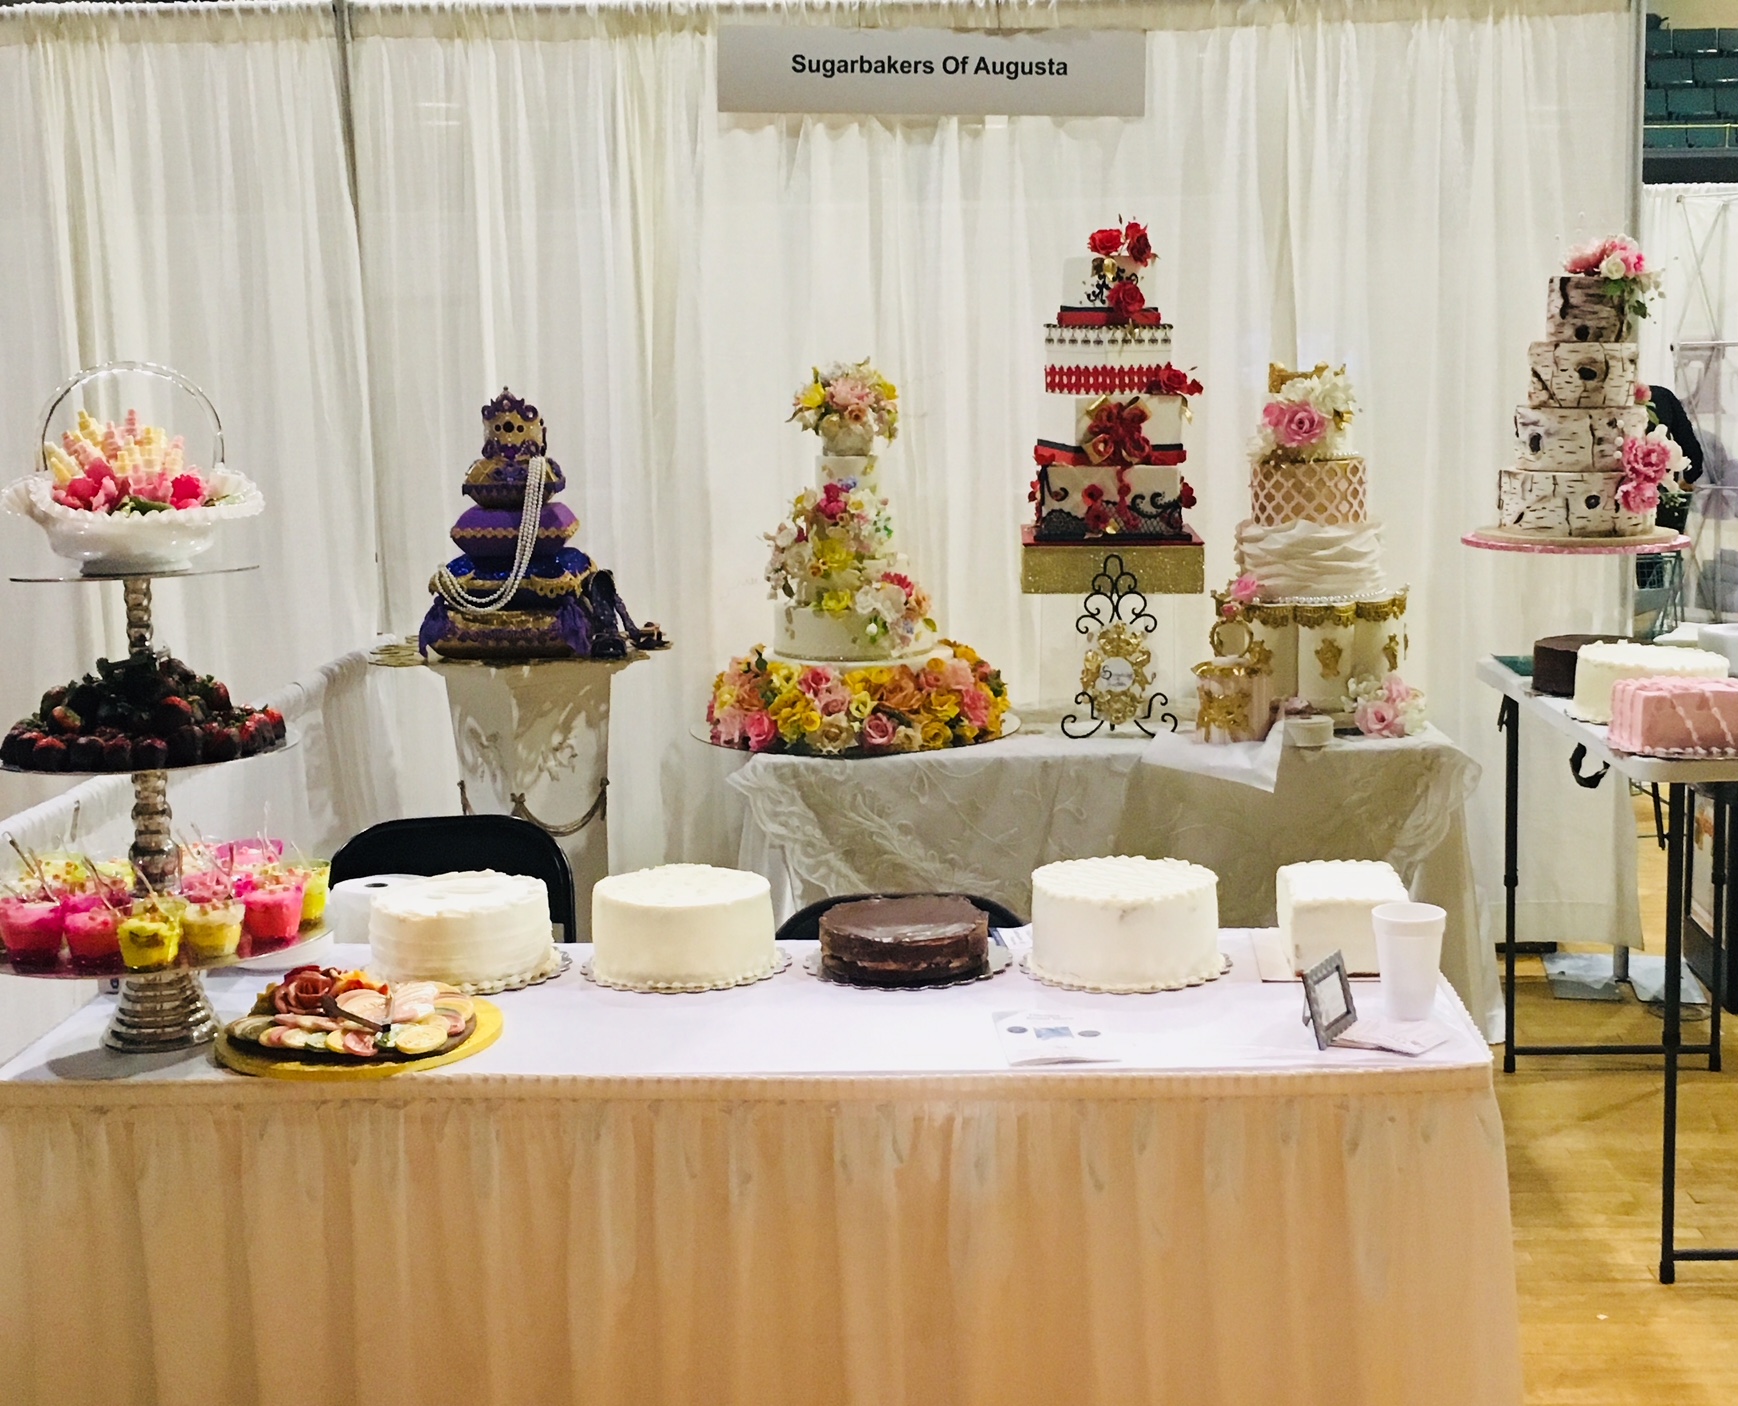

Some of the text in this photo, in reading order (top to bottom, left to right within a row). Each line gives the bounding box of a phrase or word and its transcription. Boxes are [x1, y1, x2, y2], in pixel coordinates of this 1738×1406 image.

[791, 54, 1068, 81] Sugarbakers Of Augusta
